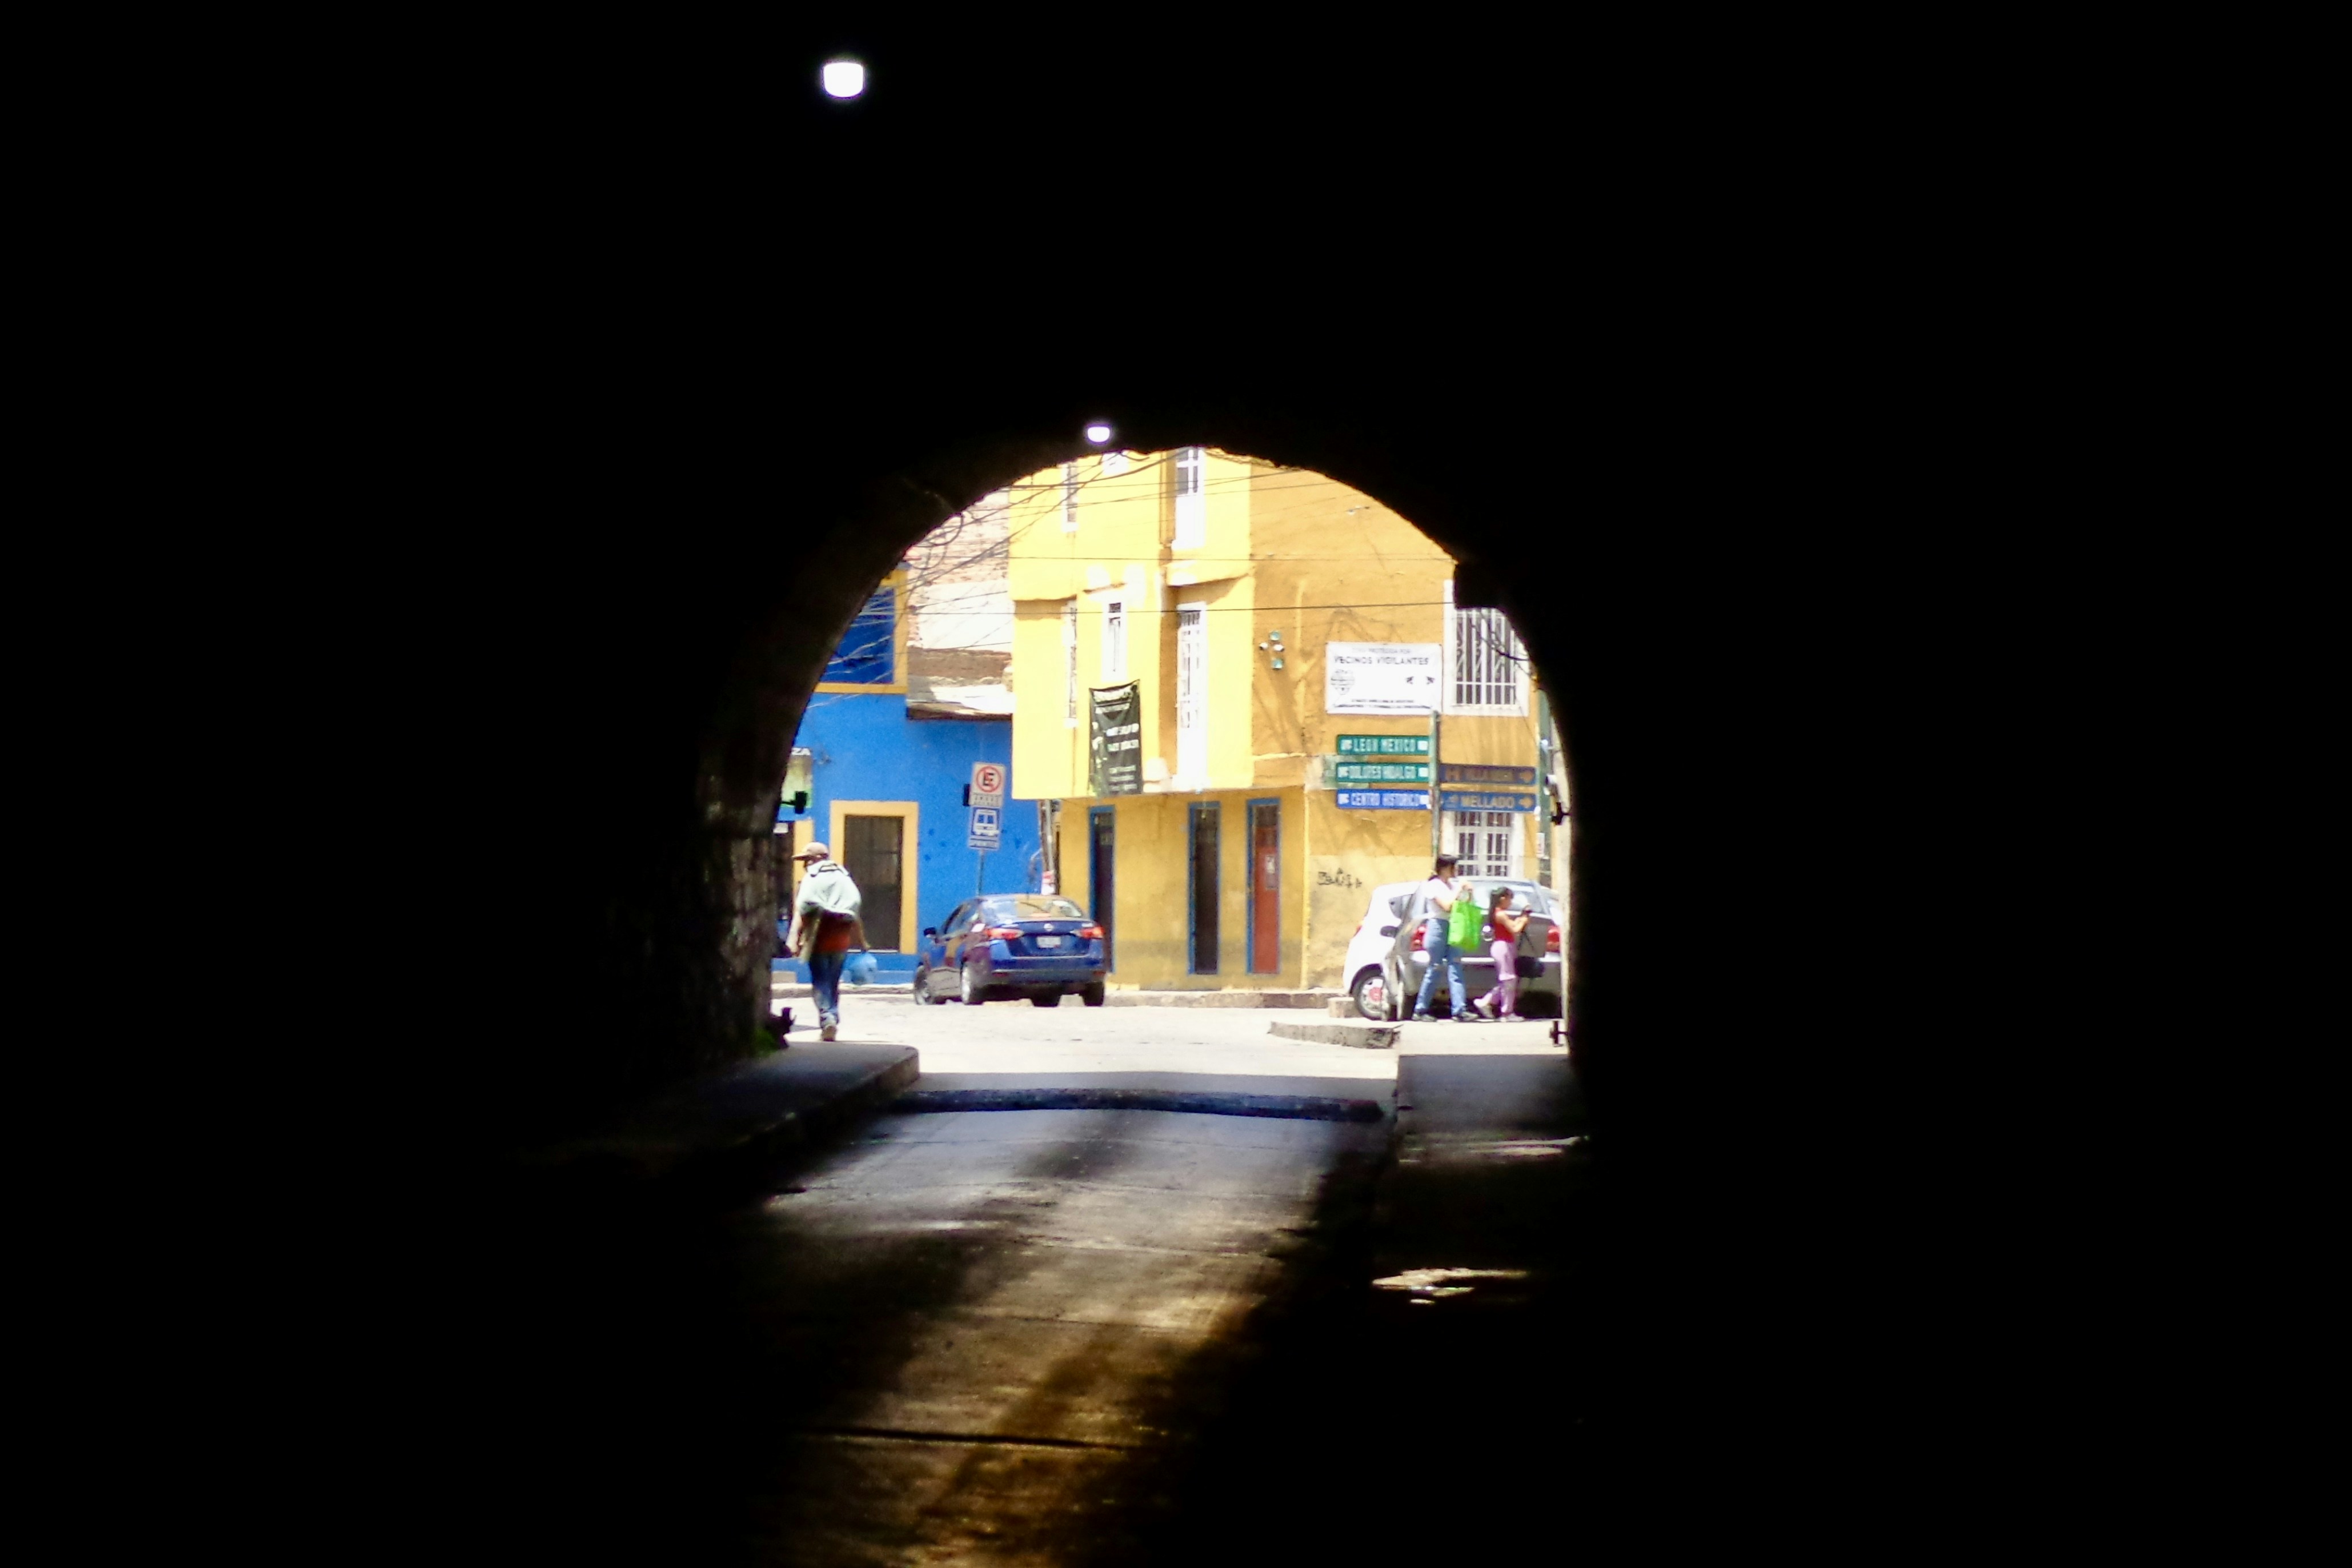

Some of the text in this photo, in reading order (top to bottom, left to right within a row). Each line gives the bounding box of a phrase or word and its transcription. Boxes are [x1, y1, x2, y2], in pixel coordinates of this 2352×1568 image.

[1335, 656, 1429, 665] VECINOS VIGILANTES
[983, 773, 995, 786] E
[1351, 793, 1380, 807] CENTRO
[1460, 795, 1515, 809] MELLADO
